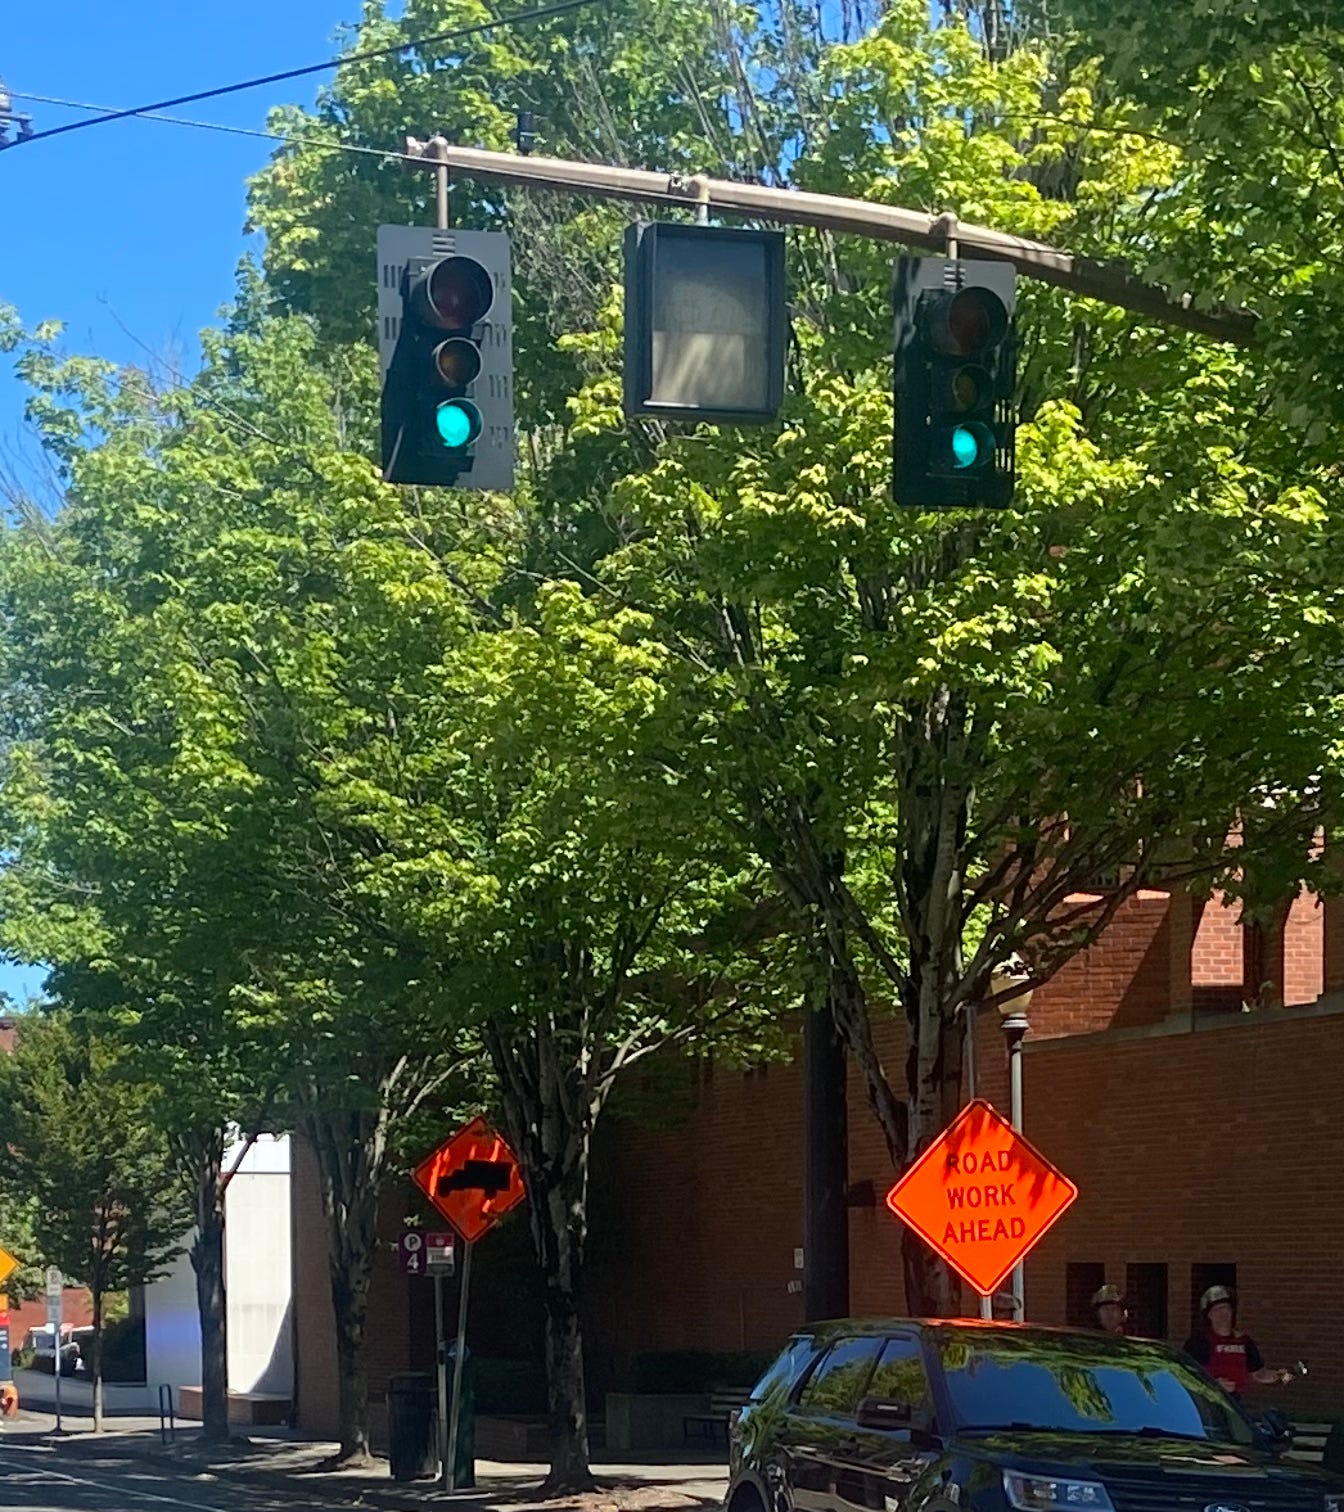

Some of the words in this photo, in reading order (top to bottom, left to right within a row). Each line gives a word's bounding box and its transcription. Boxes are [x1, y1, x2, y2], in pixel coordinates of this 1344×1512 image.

[945, 1150, 1014, 1175] ROAD
[946, 1183, 1016, 1210] WORK
[942, 1217, 1026, 1245] AHEAD
[406, 1252, 419, 1270] 4
